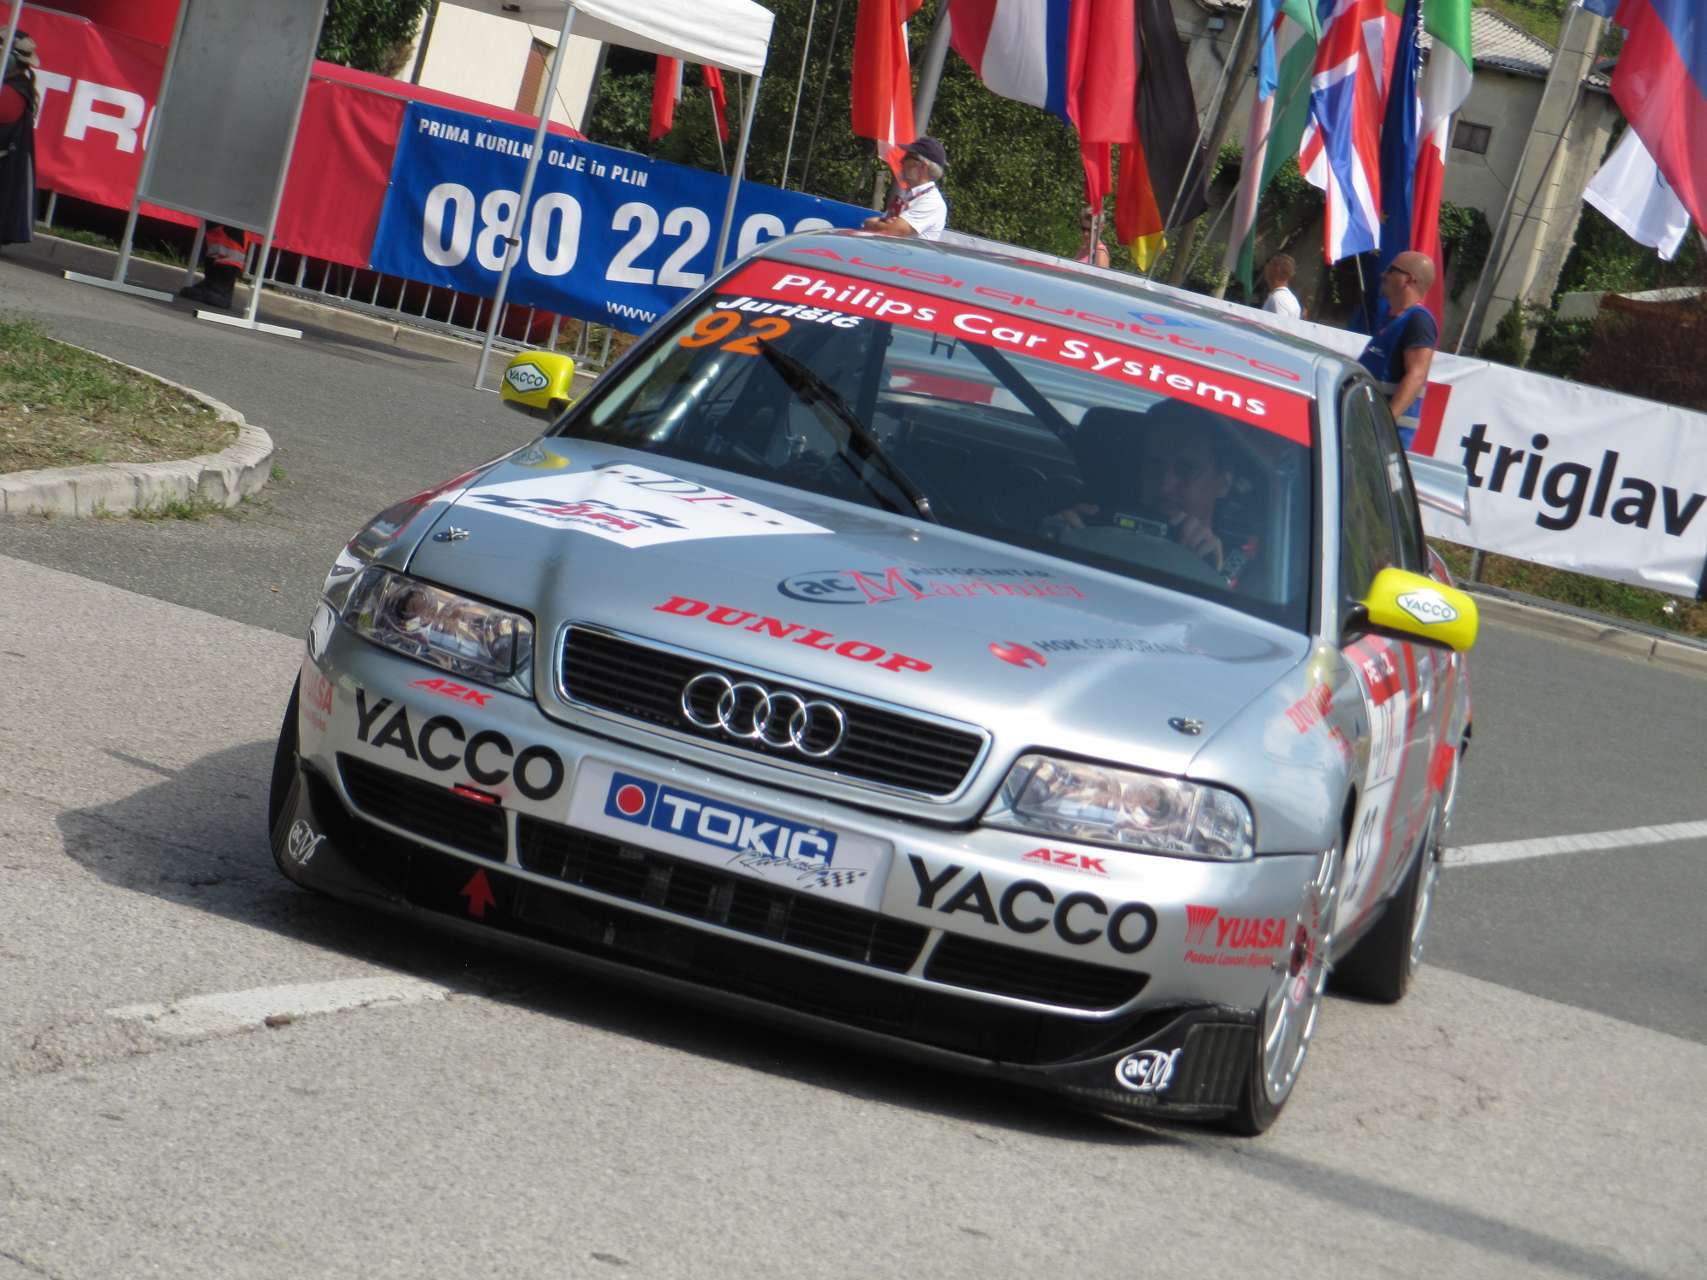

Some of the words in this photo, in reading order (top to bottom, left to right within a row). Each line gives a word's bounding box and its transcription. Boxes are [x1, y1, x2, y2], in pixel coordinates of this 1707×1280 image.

[418, 118, 469, 145] PRIMA
[548, 150, 585, 173] OLJE
[590, 160, 606, 178] in
[611, 165, 648, 188] PLIN
[422, 183, 582, 276] 080
[605, 202, 711, 289] 22
[678, 310, 791, 356] 92
[771, 274, 937, 321] Philips
[952, 313, 1046, 348] Car
[1059, 338, 1266, 416] Systems
[509, 369, 544, 387] YACCO
[1460, 423, 1707, 537] triglav
[652, 594, 933, 673] DUNLOP
[1404, 596, 1452, 618] YACCO
[411, 676, 496, 707] AZK
[355, 687, 565, 801] YACCO
[663, 794, 829, 863] TOKIĆ
[1022, 847, 1108, 874] AZK
[907, 853, 1158, 954] YACCO
[1215, 916, 1286, 949] YUASA
